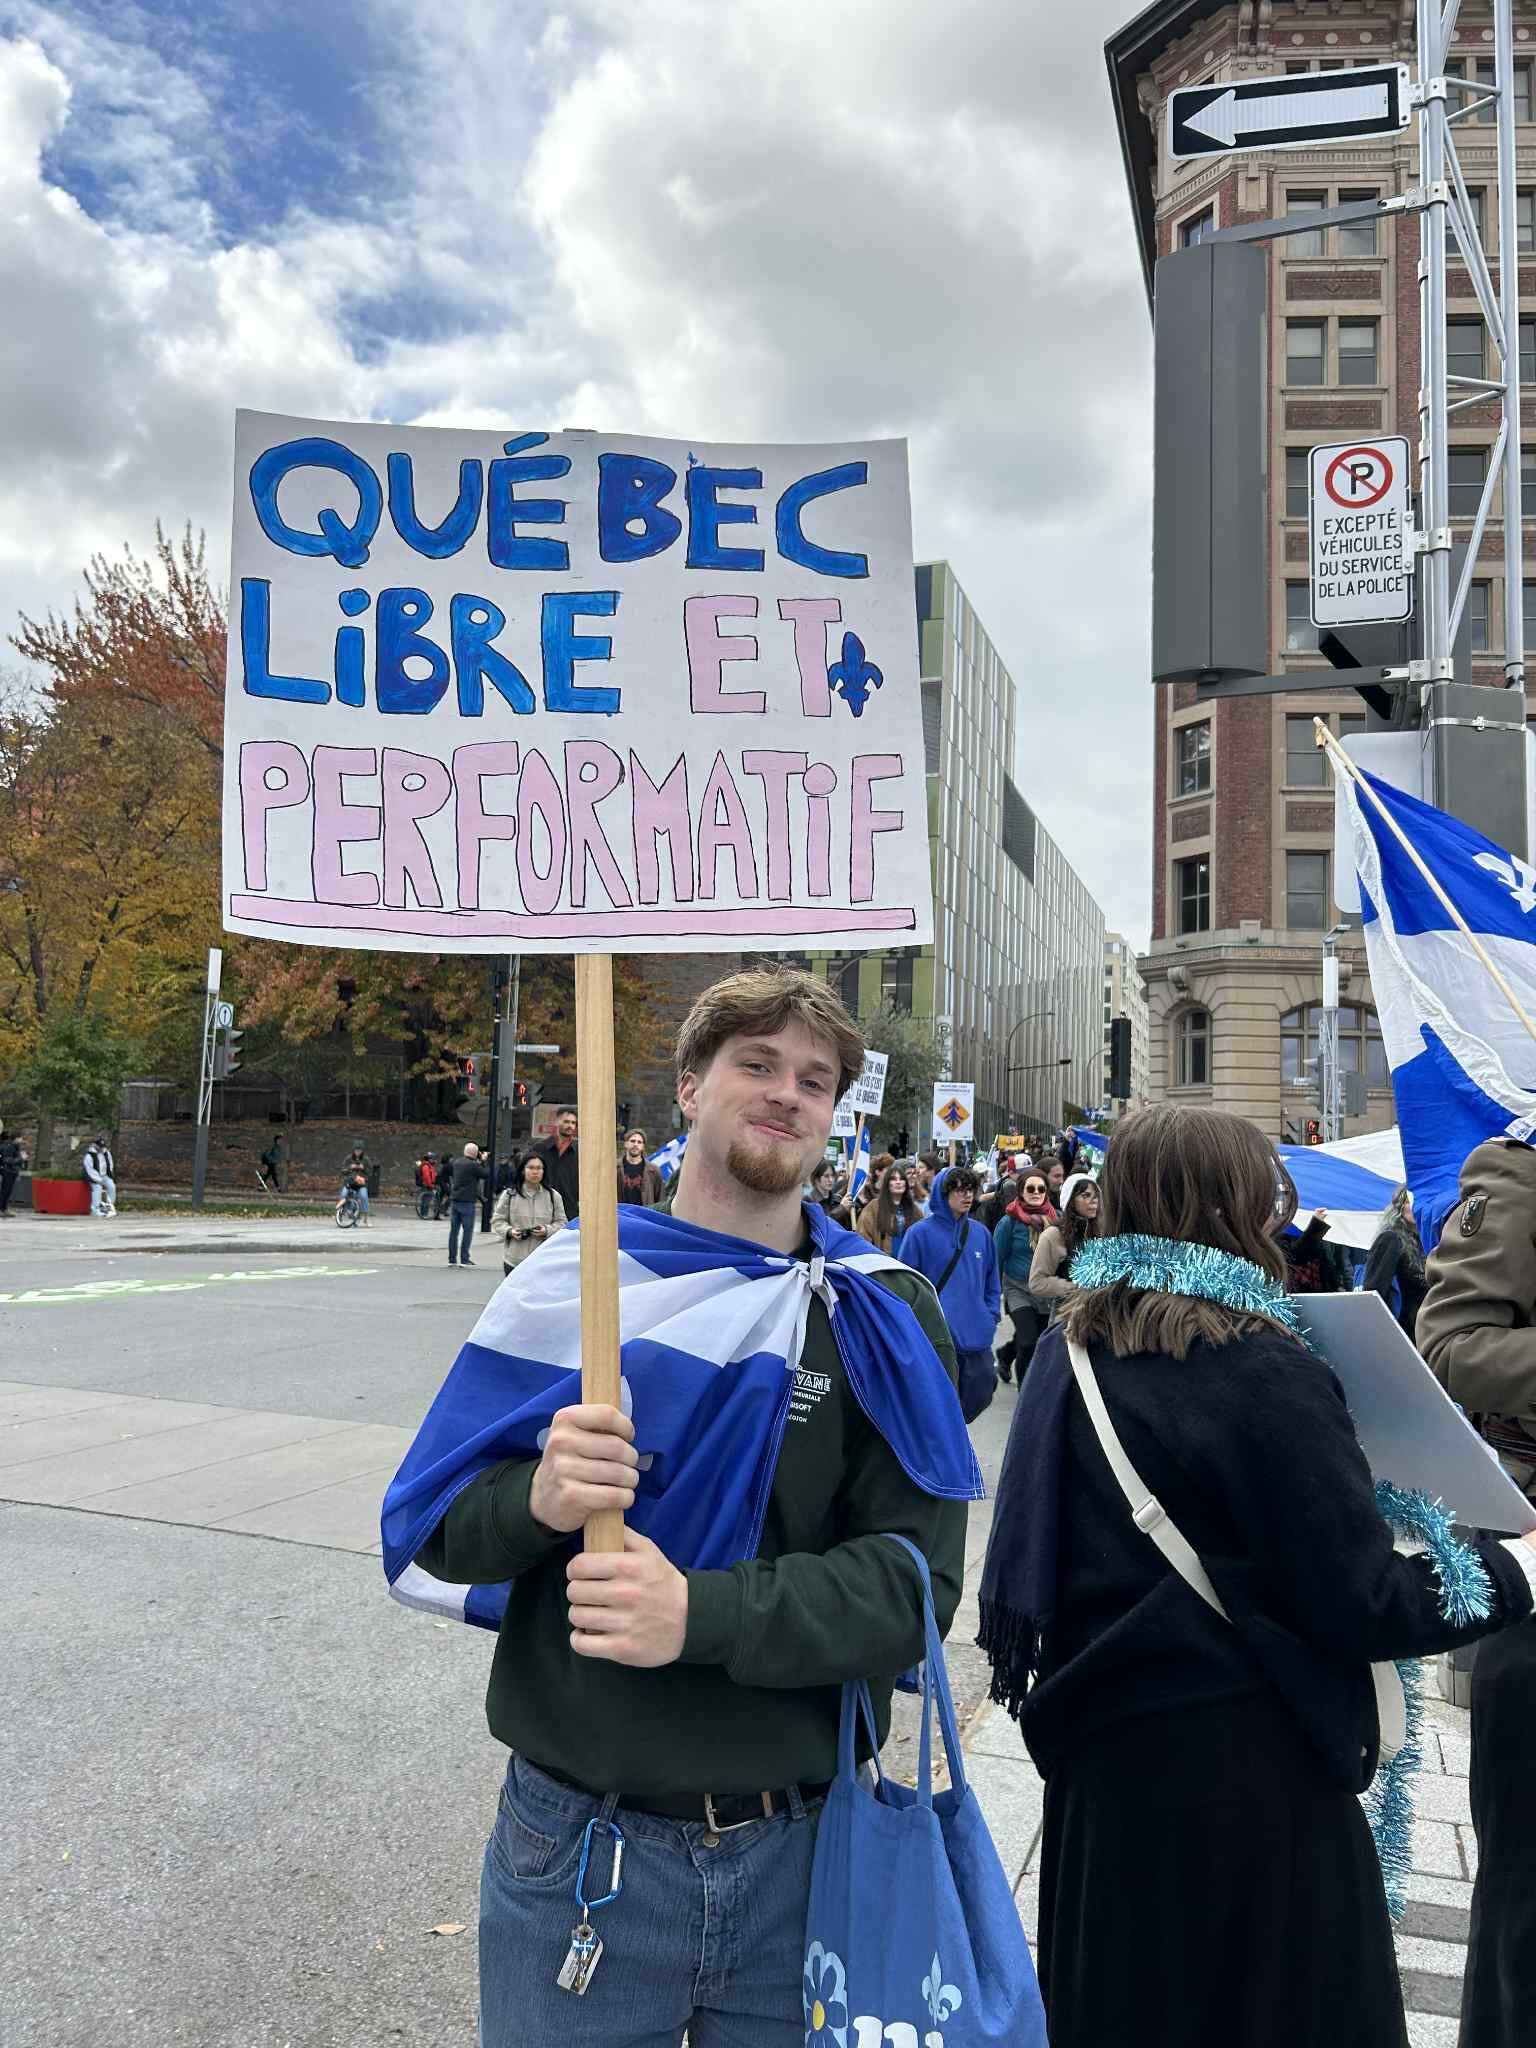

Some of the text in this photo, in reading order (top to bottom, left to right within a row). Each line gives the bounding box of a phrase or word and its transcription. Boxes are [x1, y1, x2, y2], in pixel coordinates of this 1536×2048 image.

[250, 432, 869, 579] QUÉBEC
[1323, 508, 1397, 536] EXCEPTÉ
[1319, 534, 1402, 556] VÉHICULES
[1319, 555, 1403, 577] DU SERVICE
[1319, 576, 1404, 598] DE LA POLICE
[684, 594, 843, 718] ET
[793, 1371, 831, 1392] VANE
